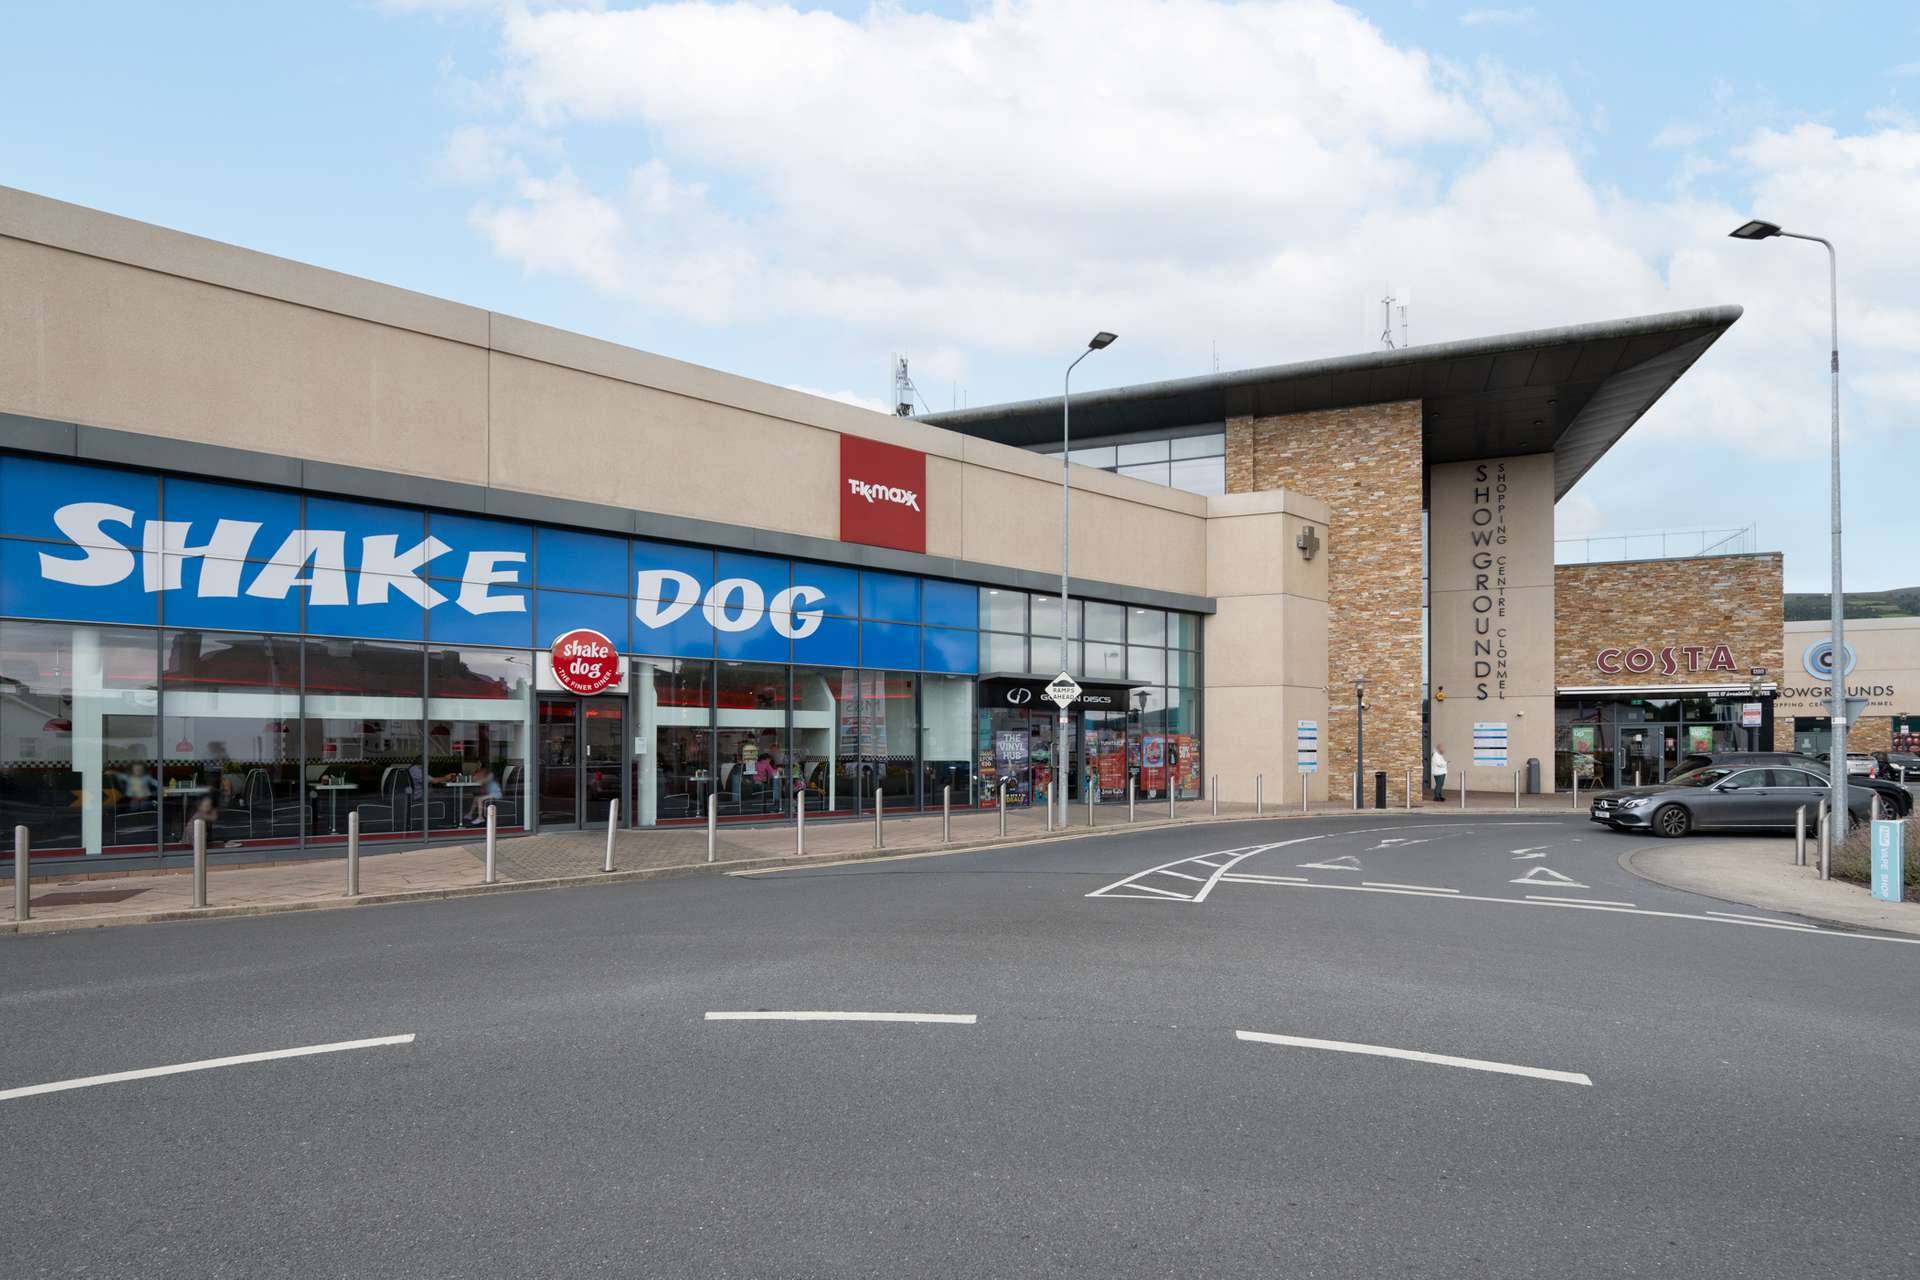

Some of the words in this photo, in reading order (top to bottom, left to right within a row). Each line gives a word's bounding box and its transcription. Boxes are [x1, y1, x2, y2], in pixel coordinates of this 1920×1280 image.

[1496, 463, 1507, 545] SHOPPING
[39, 502, 527, 616] SHAKE
[635, 569, 825, 639] DOG
[1472, 465, 1493, 700] SHOWGROUNDS
[1496, 556, 1507, 617] CENTRE
[563, 640, 609, 658] shake
[1596, 644, 1737, 676] COSTA
[570, 658, 603, 679] dog
[1496, 628, 1507, 699] CLONMEL
[559, 669, 570, 683] THE
[570, 681, 592, 690] FINER
[593, 671, 611, 688] DINER
[1777, 685, 1894, 698] OWGRUNDS
[1000, 743, 1025, 751] VINYL
[1003, 734, 1021, 742] THE
[1003, 752, 1021, 760] HUB
[1880, 848, 1889, 870] VAPE
[1880, 874, 1889, 898] SHOP
